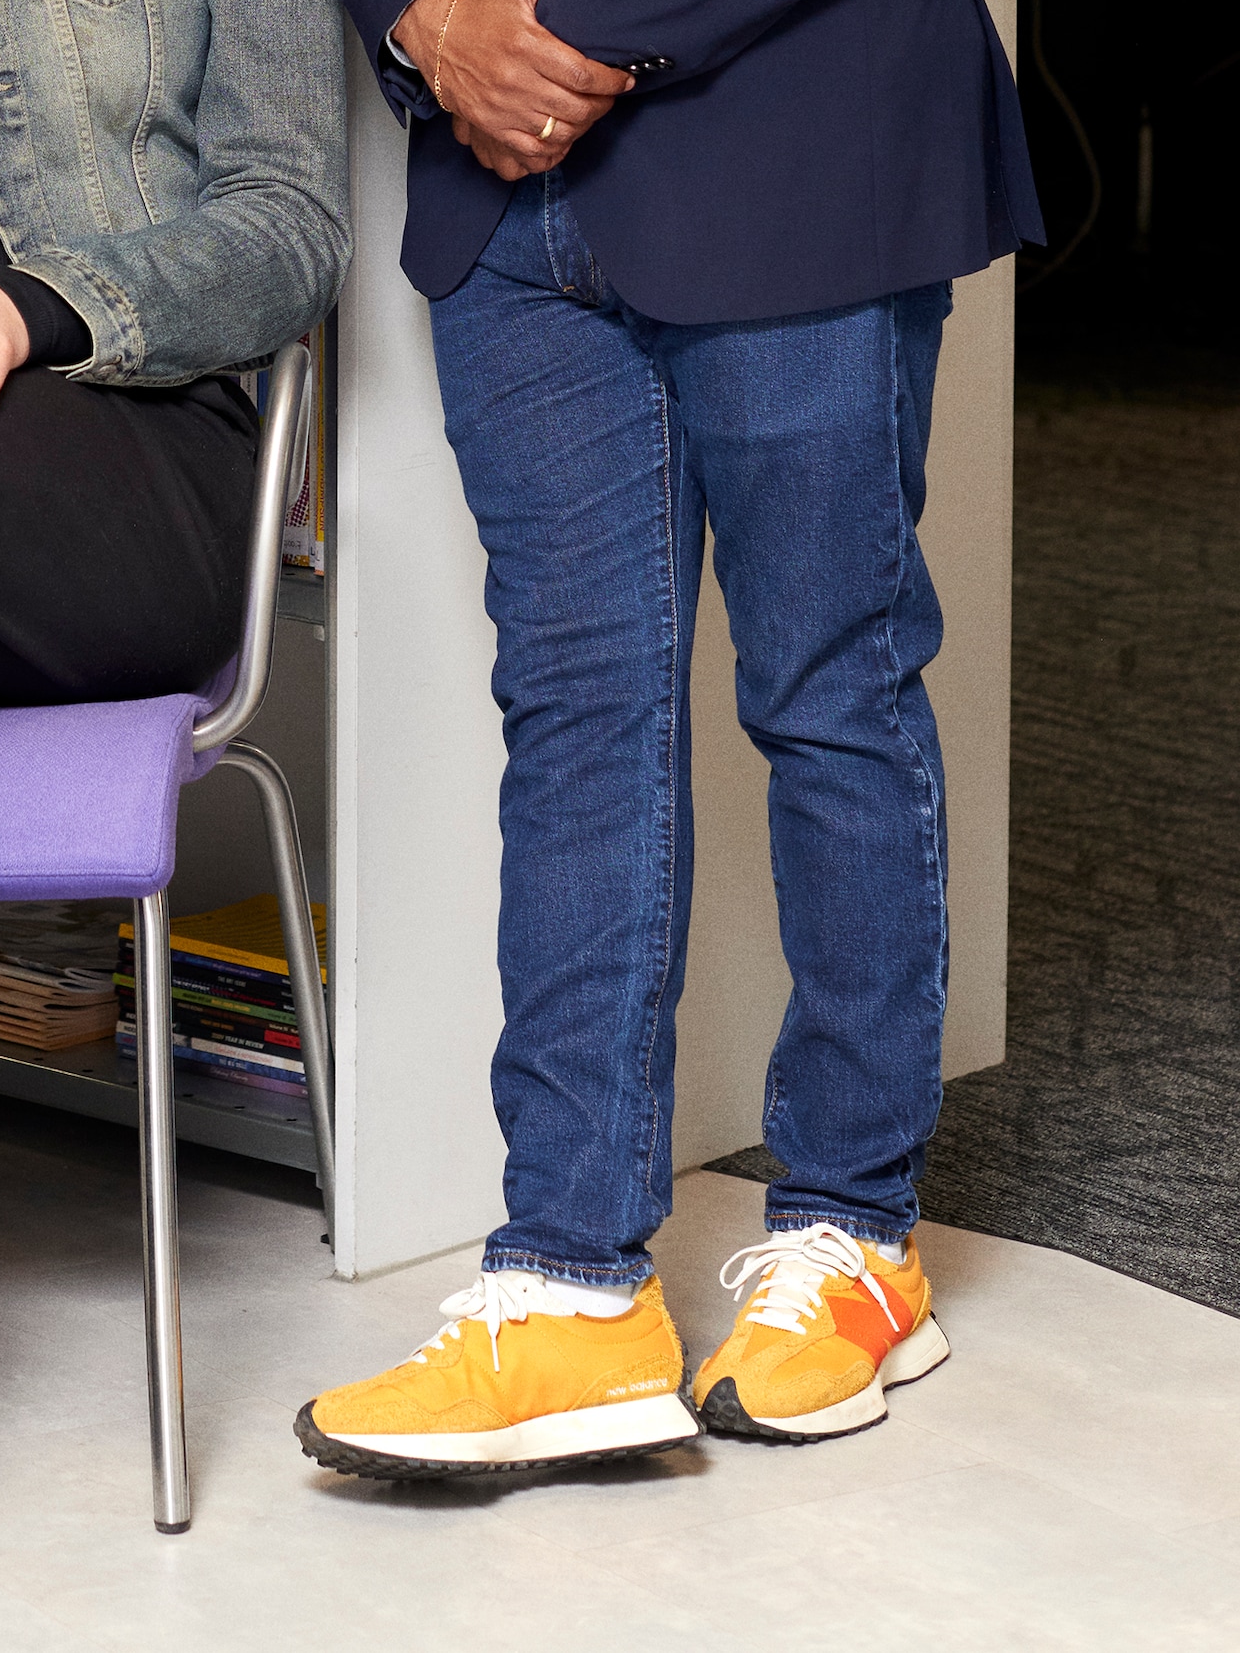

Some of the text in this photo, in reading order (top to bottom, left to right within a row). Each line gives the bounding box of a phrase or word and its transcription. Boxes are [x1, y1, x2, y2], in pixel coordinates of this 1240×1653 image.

[245, 1039, 265, 1050] REVIEW
[606, 1376, 668, 1397] new balance
